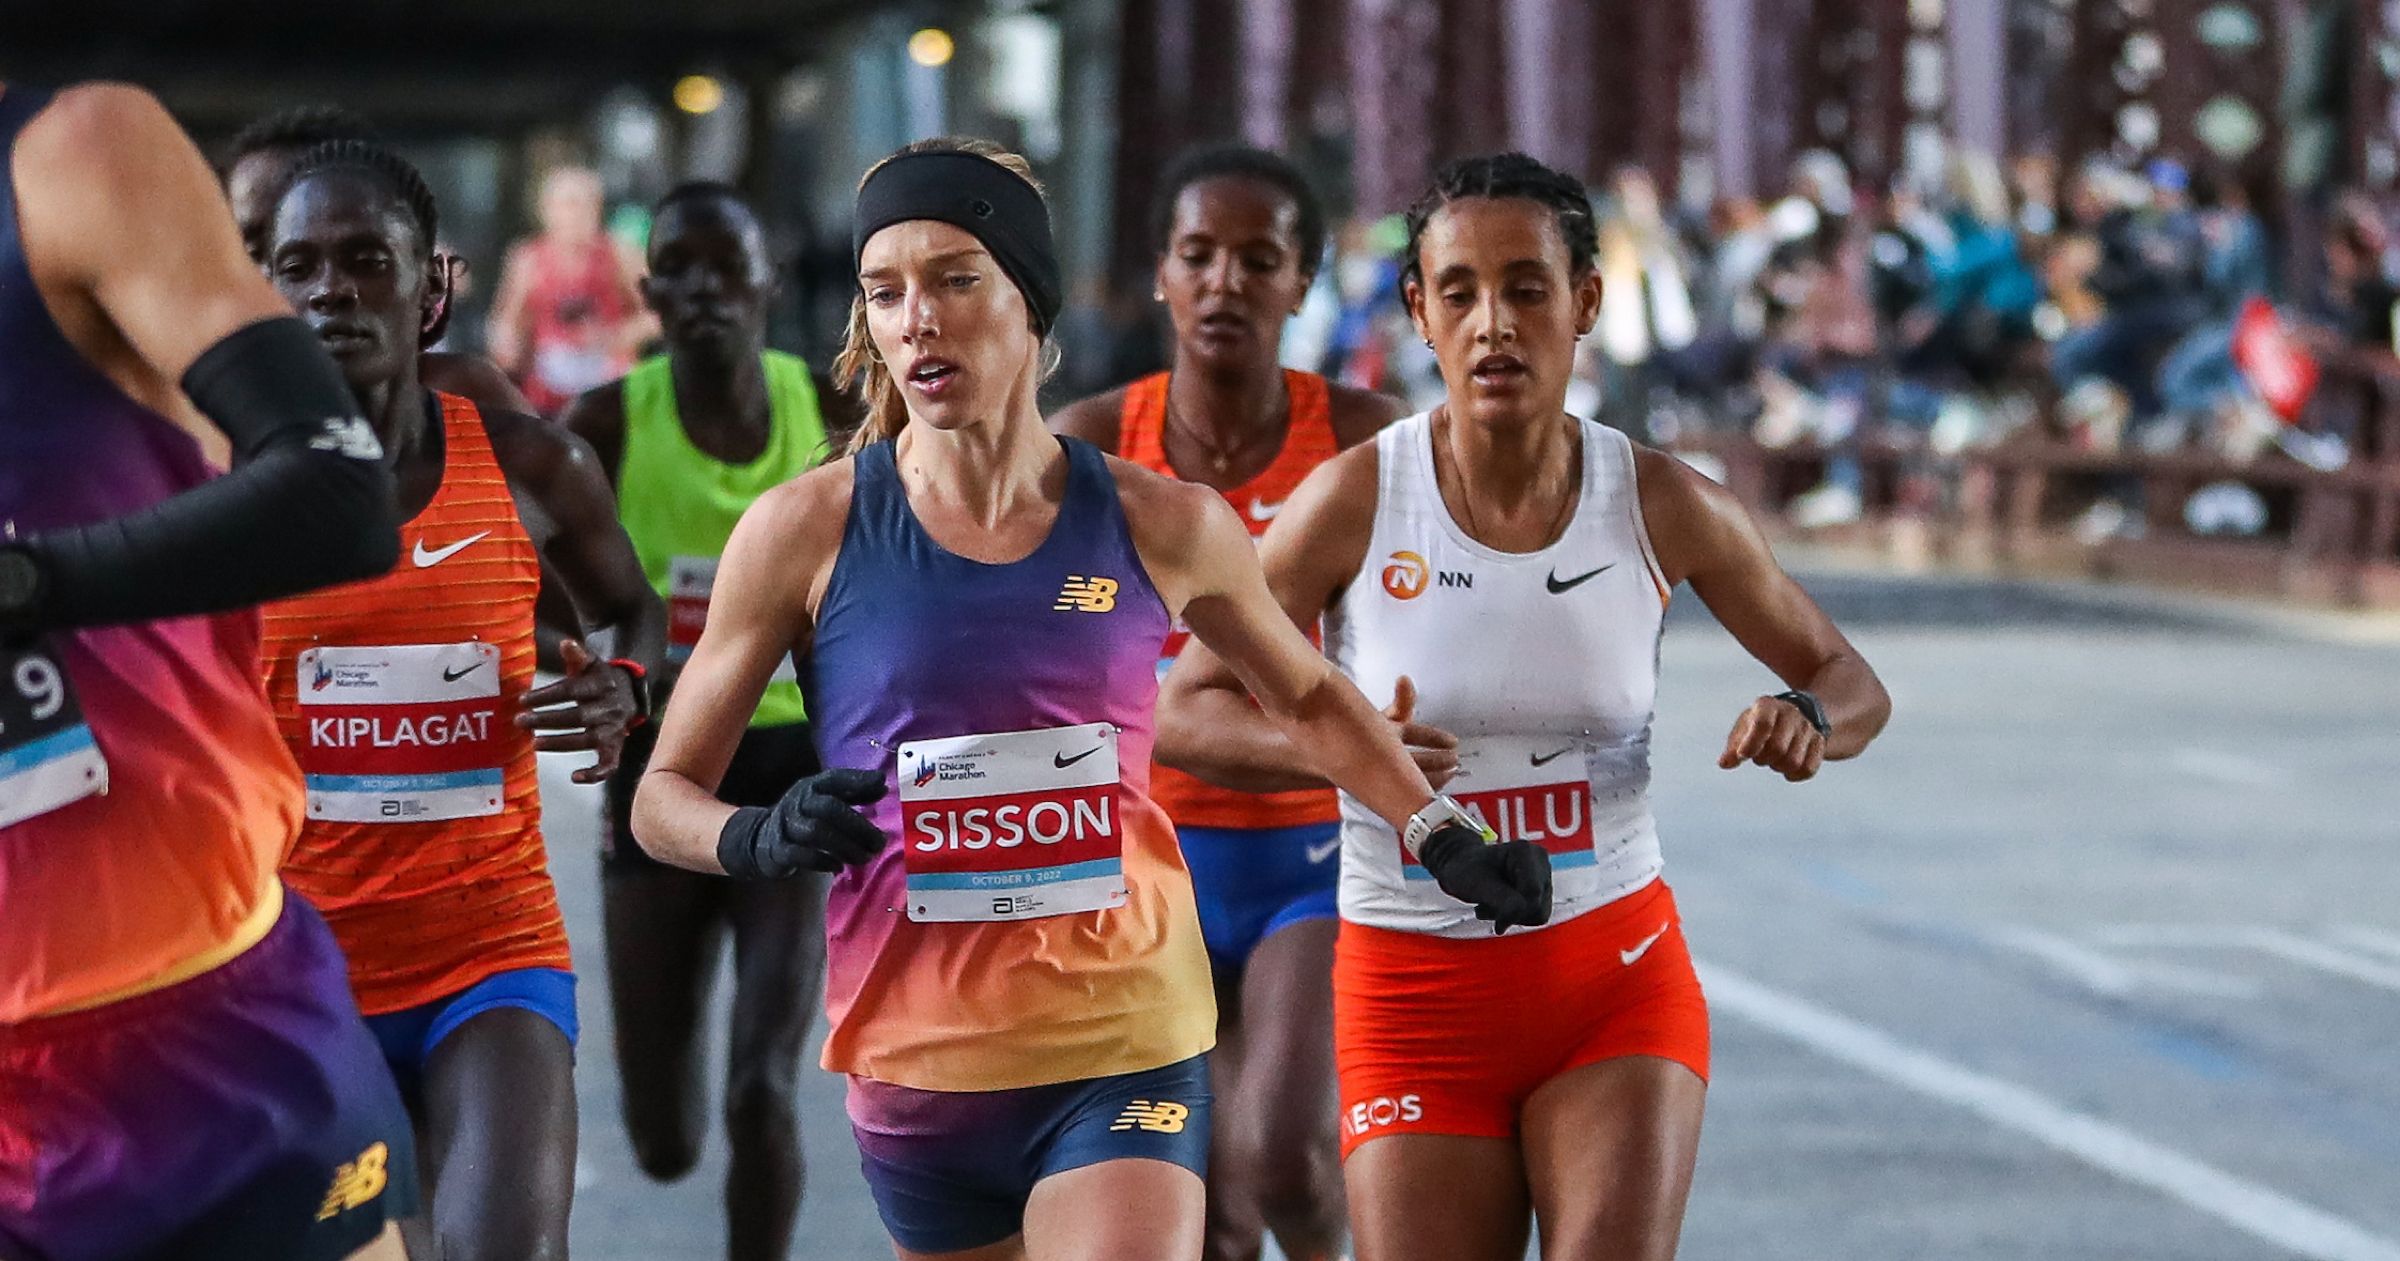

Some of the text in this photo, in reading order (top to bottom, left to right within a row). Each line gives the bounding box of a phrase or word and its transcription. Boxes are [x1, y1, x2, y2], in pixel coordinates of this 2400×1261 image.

[1439, 571, 1473, 588] NN
[0, 656, 65, 734] 9
[310, 711, 494, 747] KIPLAGAT
[938, 762, 976, 772] Chicago
[939, 768, 986, 781] Marathon
[914, 796, 1112, 851] SISSON
[1465, 789, 1582, 843] AILU
[972, 874, 1022, 886] OCTOBER
[1037, 870, 1061, 882] 2022
